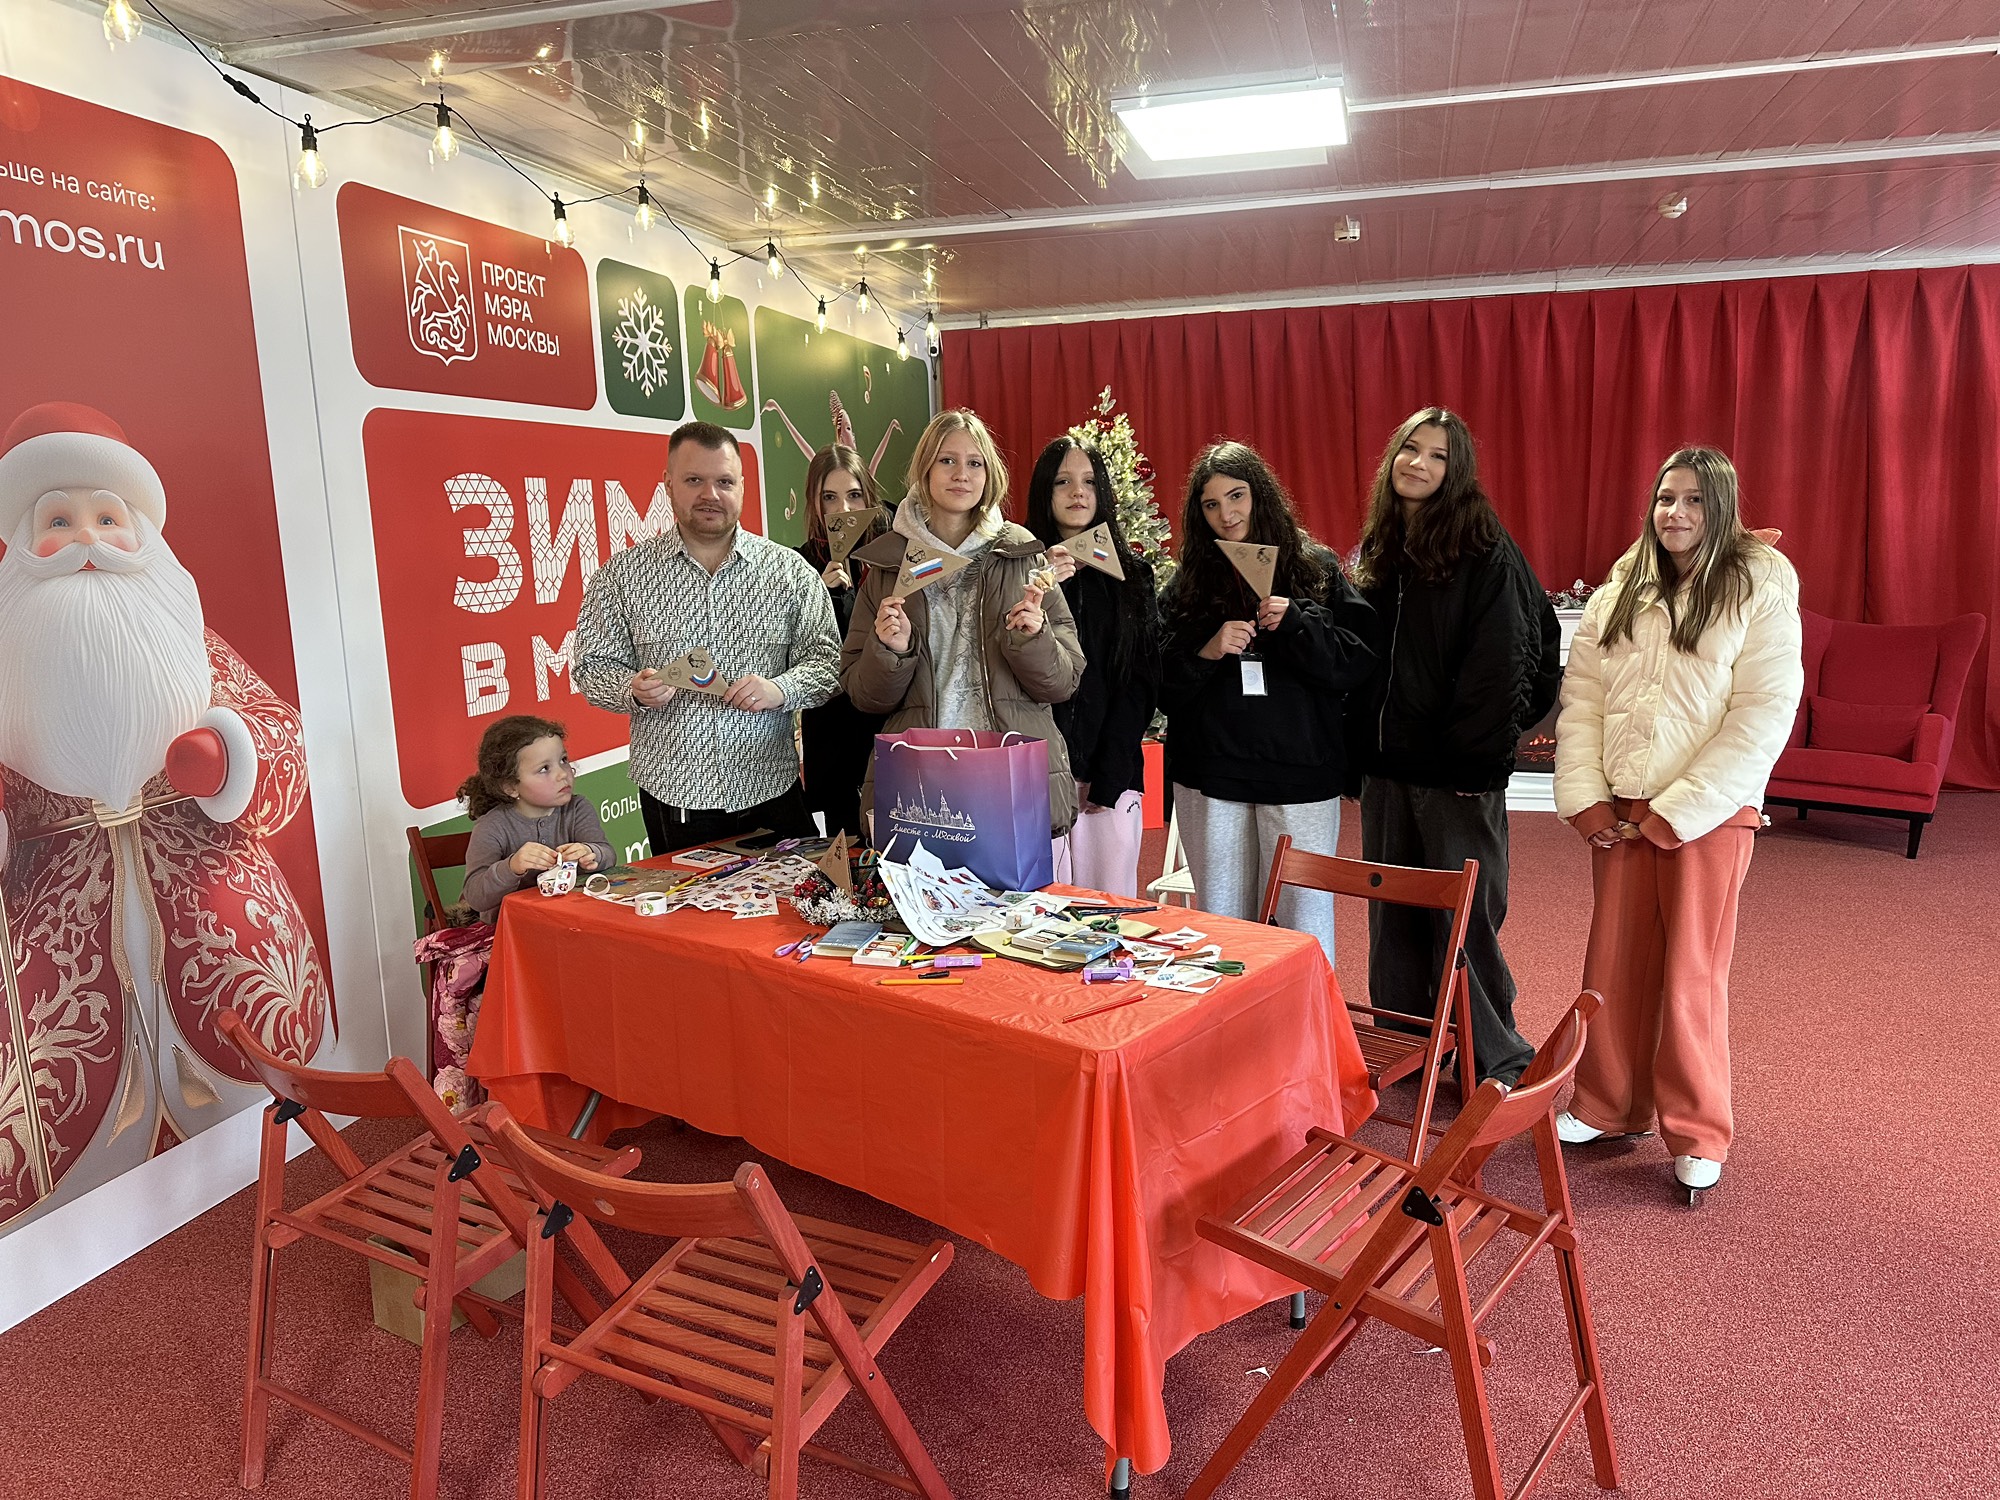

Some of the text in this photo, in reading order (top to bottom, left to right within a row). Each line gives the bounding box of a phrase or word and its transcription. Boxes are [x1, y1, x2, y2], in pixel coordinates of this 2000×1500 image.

[51, 171, 80, 194] на
[86, 181, 156, 212] сайте:
[0, 209, 165, 271] mos.ru
[481, 260, 546, 298] ПРОЕКТ
[484, 291, 534, 324] МЭРА
[487, 321, 560, 356] МОСКВЫ
